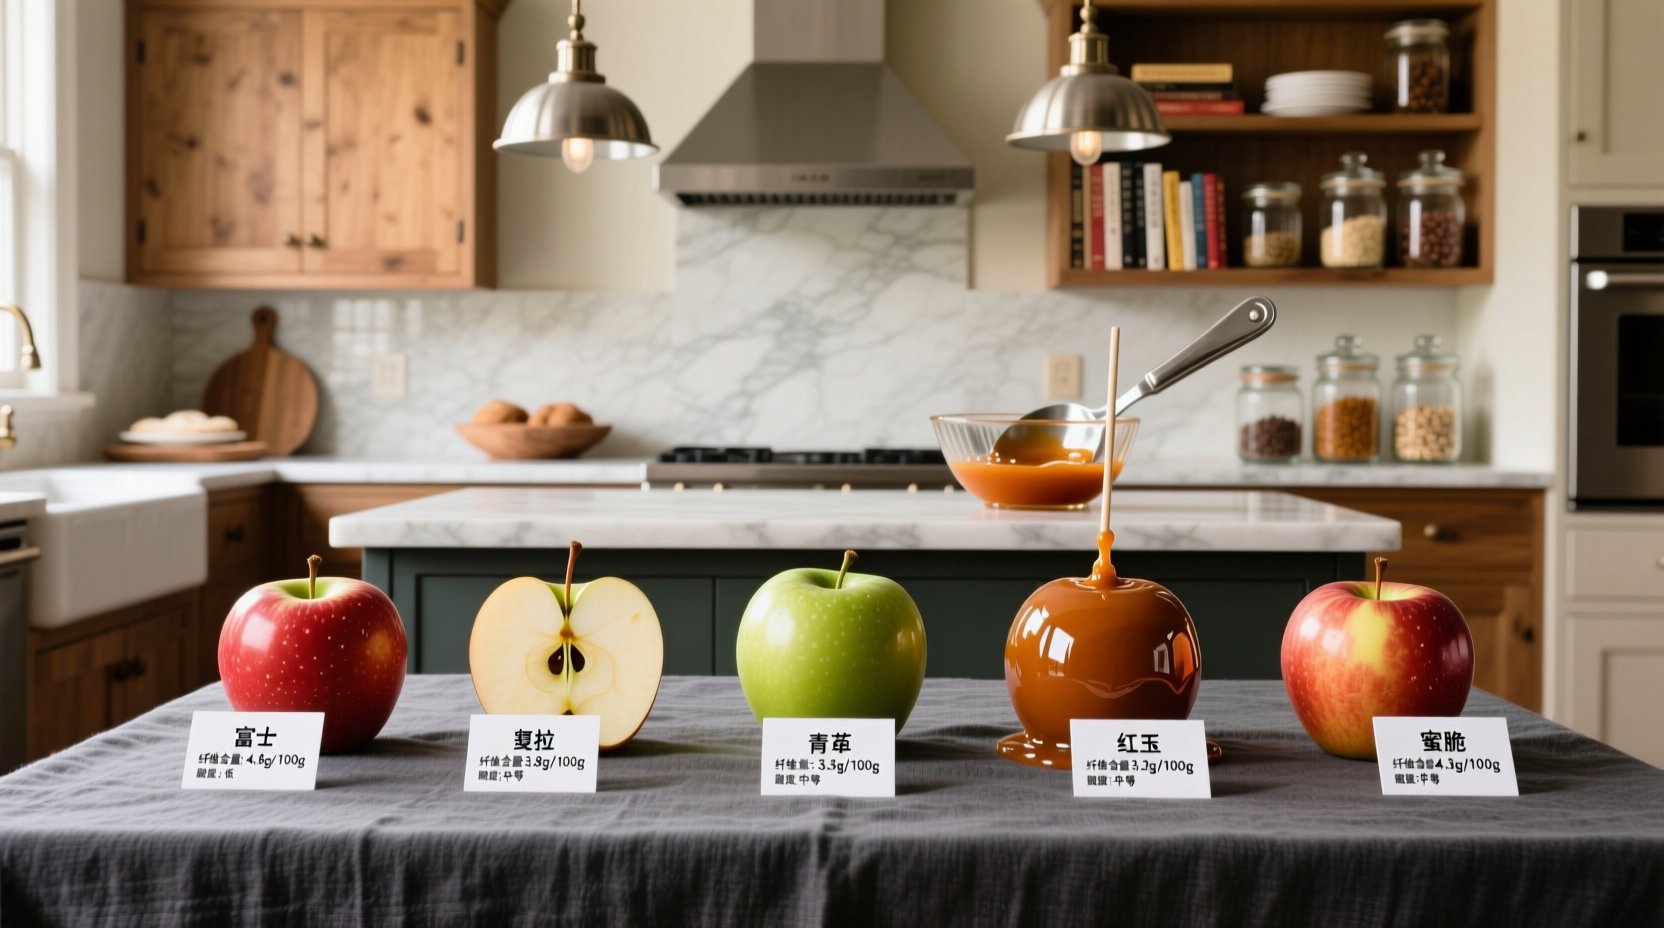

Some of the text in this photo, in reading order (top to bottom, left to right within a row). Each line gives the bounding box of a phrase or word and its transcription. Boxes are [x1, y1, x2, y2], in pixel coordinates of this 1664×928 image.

[235, 726, 277, 748] 富士
[1117, 732, 1161, 753] 红玉
[1420, 729, 1466, 752] 蜜脆
